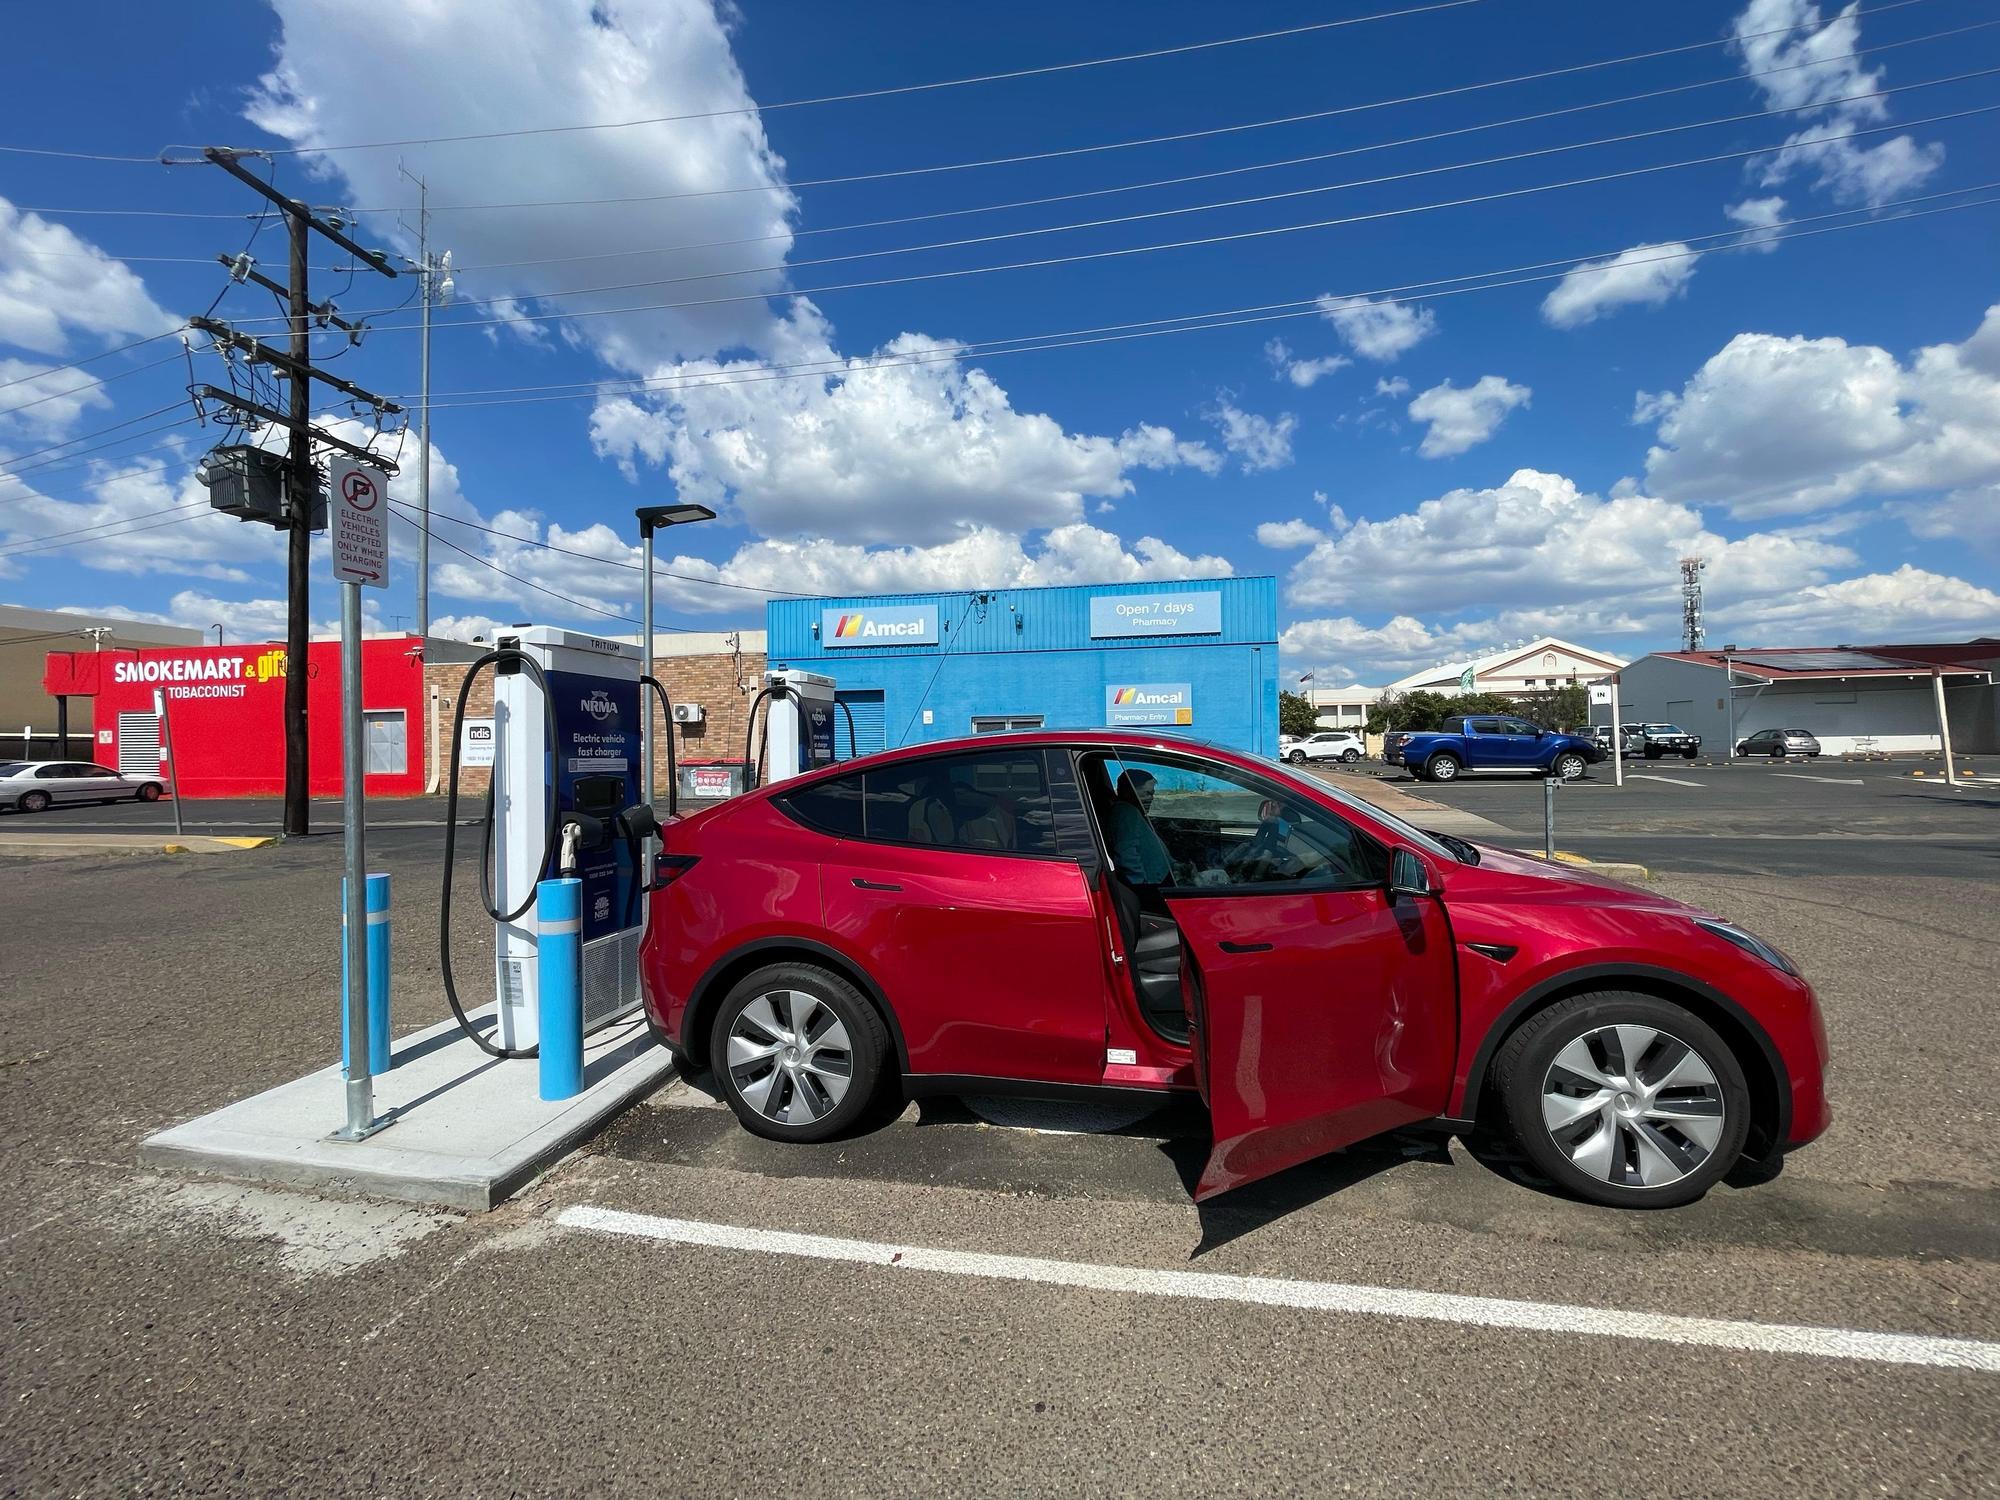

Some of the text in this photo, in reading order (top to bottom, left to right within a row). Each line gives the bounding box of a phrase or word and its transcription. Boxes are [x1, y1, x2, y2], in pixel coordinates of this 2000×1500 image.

[341, 509, 379, 527] ELECTRIC
[341, 521, 380, 538] VEHICLES
[340, 531, 381, 548] EXCEPTED
[338, 541, 384, 560] ONLY WHILE
[340, 552, 382, 569] CHARGING
[1115, 602, 1194, 616] Open 7 days
[862, 618, 924, 637] Amcal
[1132, 618, 1177, 627] Pharmacy
[590, 640, 620, 652] TRITIUM
[115, 658, 244, 683] SMOKEMART
[244, 665, 256, 678] &
[168, 685, 247, 699] TOBACCONIST
[1135, 691, 1182, 705] Amcal
[580, 699, 618, 714] NRMA
[1149, 713, 1168, 721] Entry
[470, 727, 491, 739] ndis
[573, 732, 626, 744] Electric vehicle
[578, 746, 622, 758] fast charger
[594, 908, 609, 919] NSW
